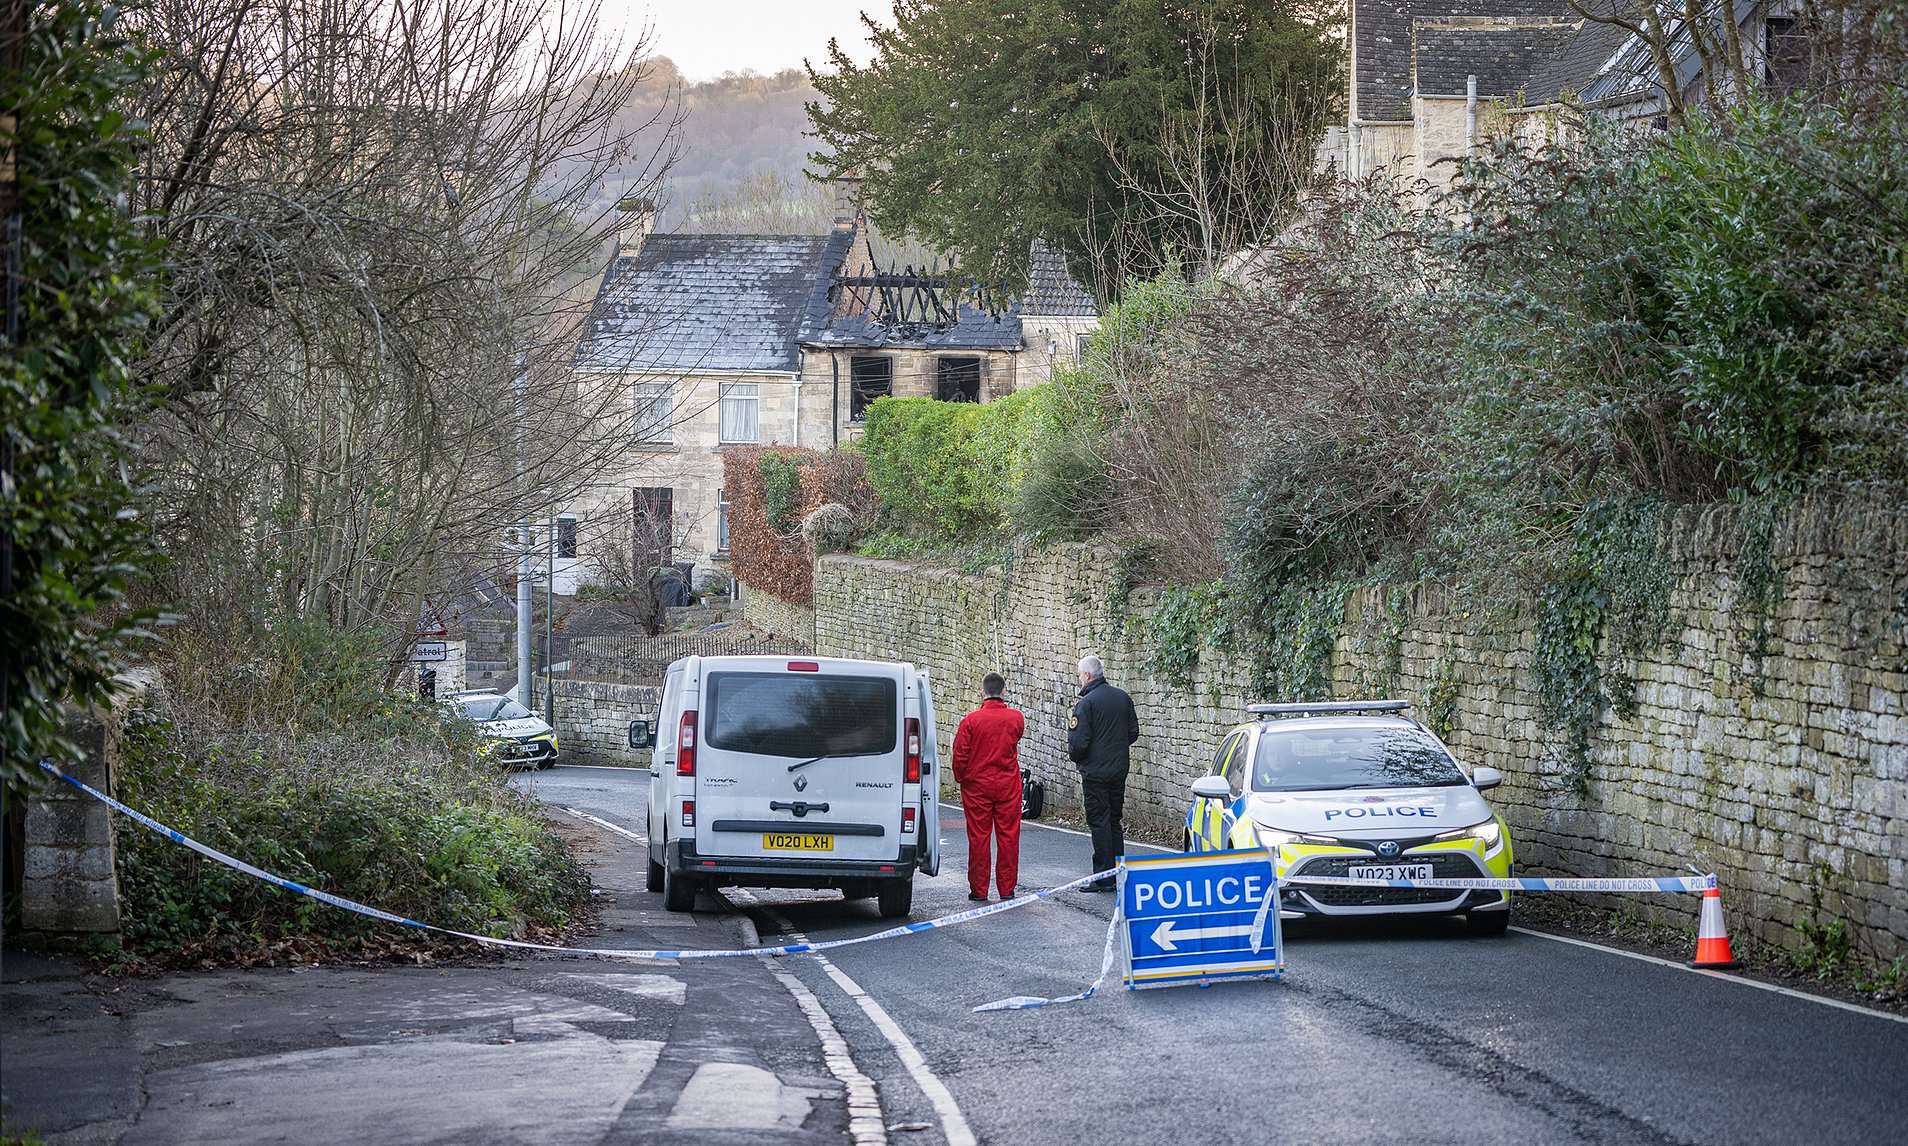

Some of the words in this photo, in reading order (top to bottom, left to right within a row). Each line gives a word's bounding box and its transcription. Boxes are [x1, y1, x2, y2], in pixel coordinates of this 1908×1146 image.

[1324, 806, 1438, 821] POLICE
[768, 836, 801, 848] VO20
[804, 837, 829, 849] LXH
[1356, 868, 1394, 880] VO23
[1398, 866, 1426, 880] XWG
[1419, 879, 1443, 887] POLICE
[1446, 879, 1461, 887] LINE
[1463, 879, 1473, 887] DO
[1475, 879, 1489, 887] NOT
[1492, 879, 1516, 888] CROSS
[1554, 880, 1580, 889] POLICE
[1582, 880, 1597, 889] LINE
[1600, 880, 1610, 889] DO
[1612, 880, 1625, 889] NOT
[1628, 879, 1652, 889] CROSS
[1135, 875, 1263, 911] POLICE
